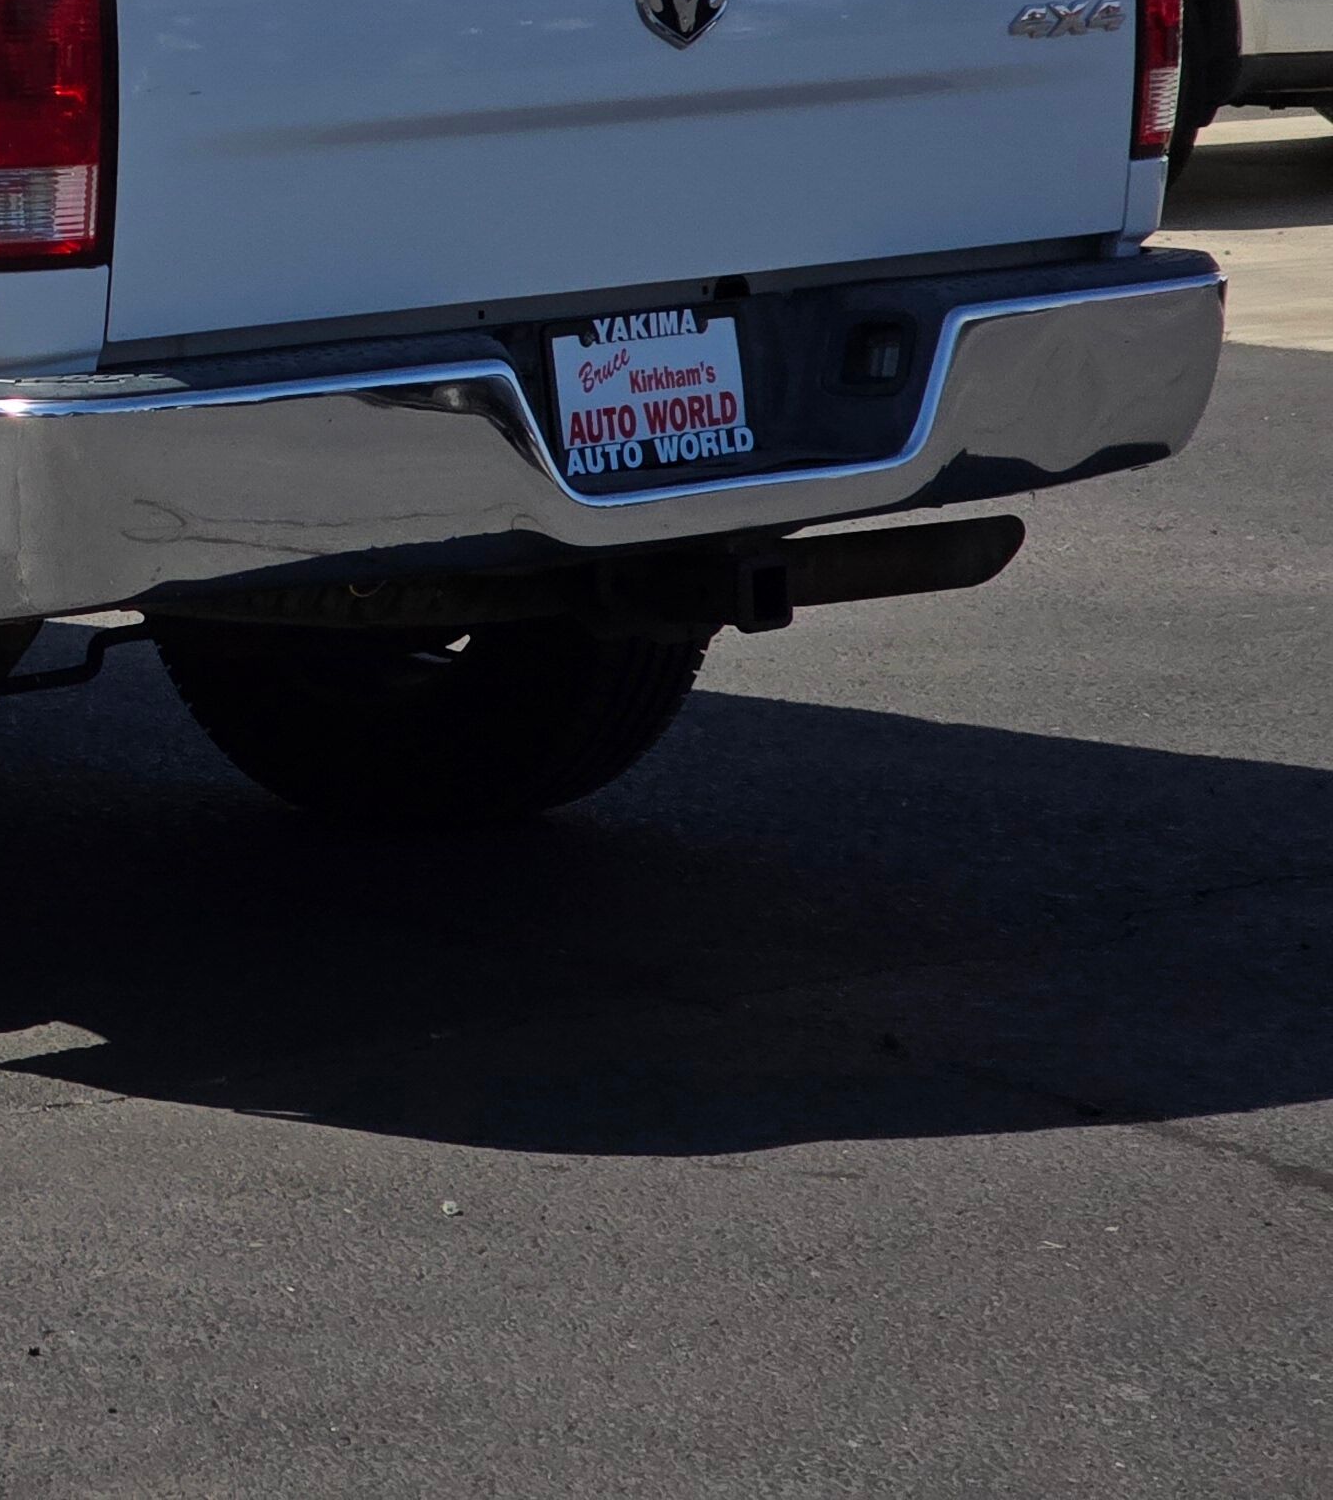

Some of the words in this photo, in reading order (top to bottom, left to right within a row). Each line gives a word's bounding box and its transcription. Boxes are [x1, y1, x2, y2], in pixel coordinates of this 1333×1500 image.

[592, 309, 699, 344] YAKIMA
[578, 348, 631, 394] Bruce
[629, 362, 716, 394] Kirkham's
[569, 404, 636, 446] AUTO
[643, 390, 738, 435] WORLD
[566, 440, 644, 477] AUTO
[653, 426, 755, 464] WORLD
